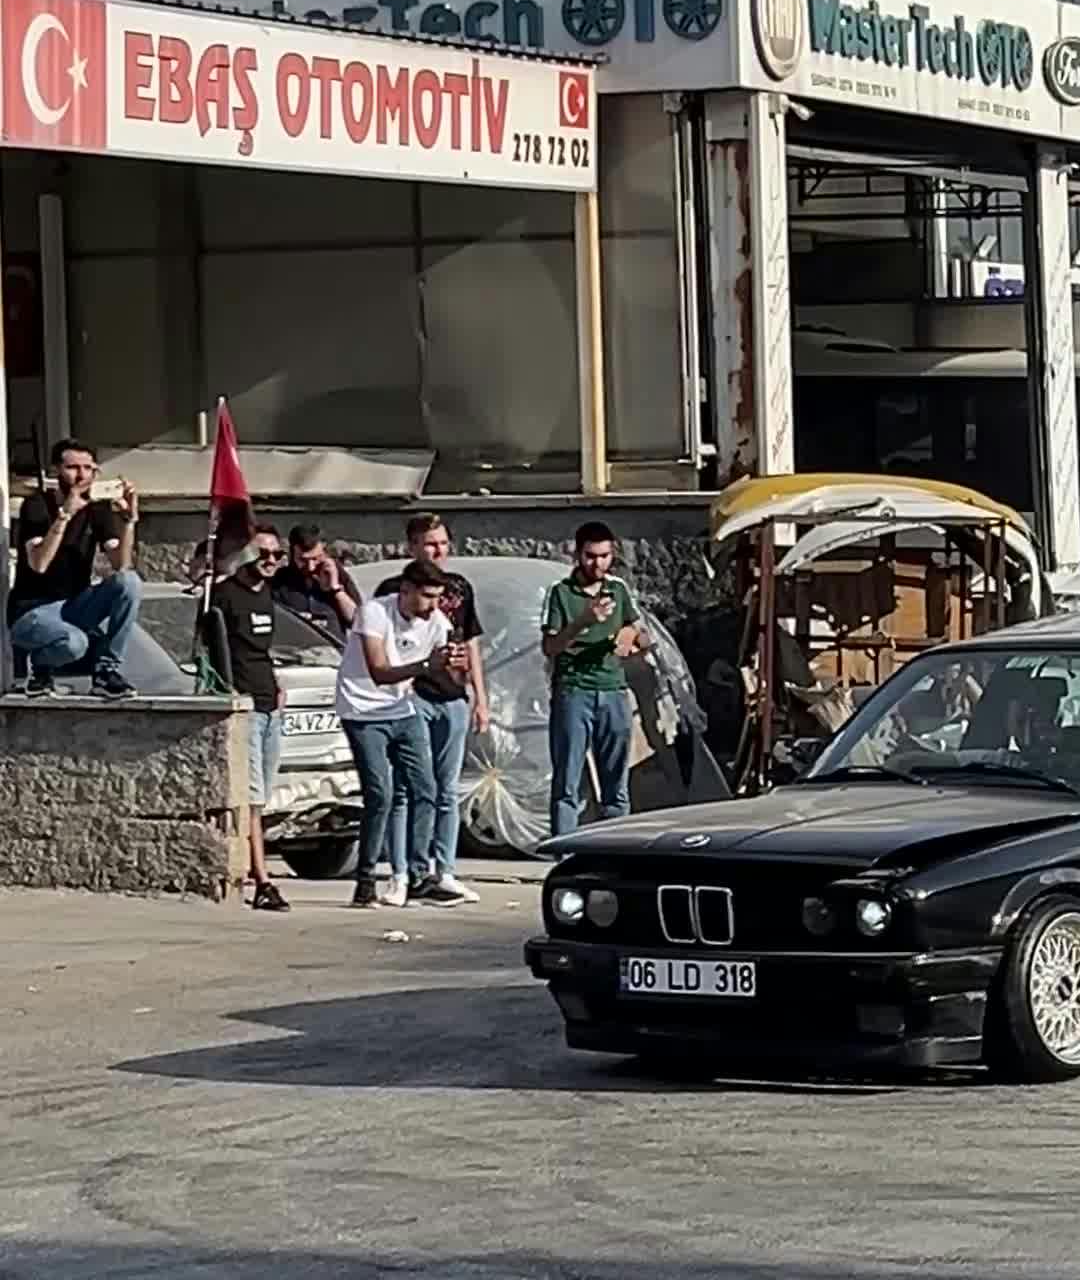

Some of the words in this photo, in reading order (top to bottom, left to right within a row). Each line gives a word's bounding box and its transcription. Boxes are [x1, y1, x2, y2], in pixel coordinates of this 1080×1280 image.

[124, 31, 258, 156] EBAŞ
[276, 52, 510, 154] OTOMOTİV
[511, 133, 542, 165] 278
[547, 136, 566, 166] 72
[570, 138, 591, 168] 02
[630, 960, 656, 989] 06
[667, 961, 701, 991] LD
[714, 963, 753, 993] 318
